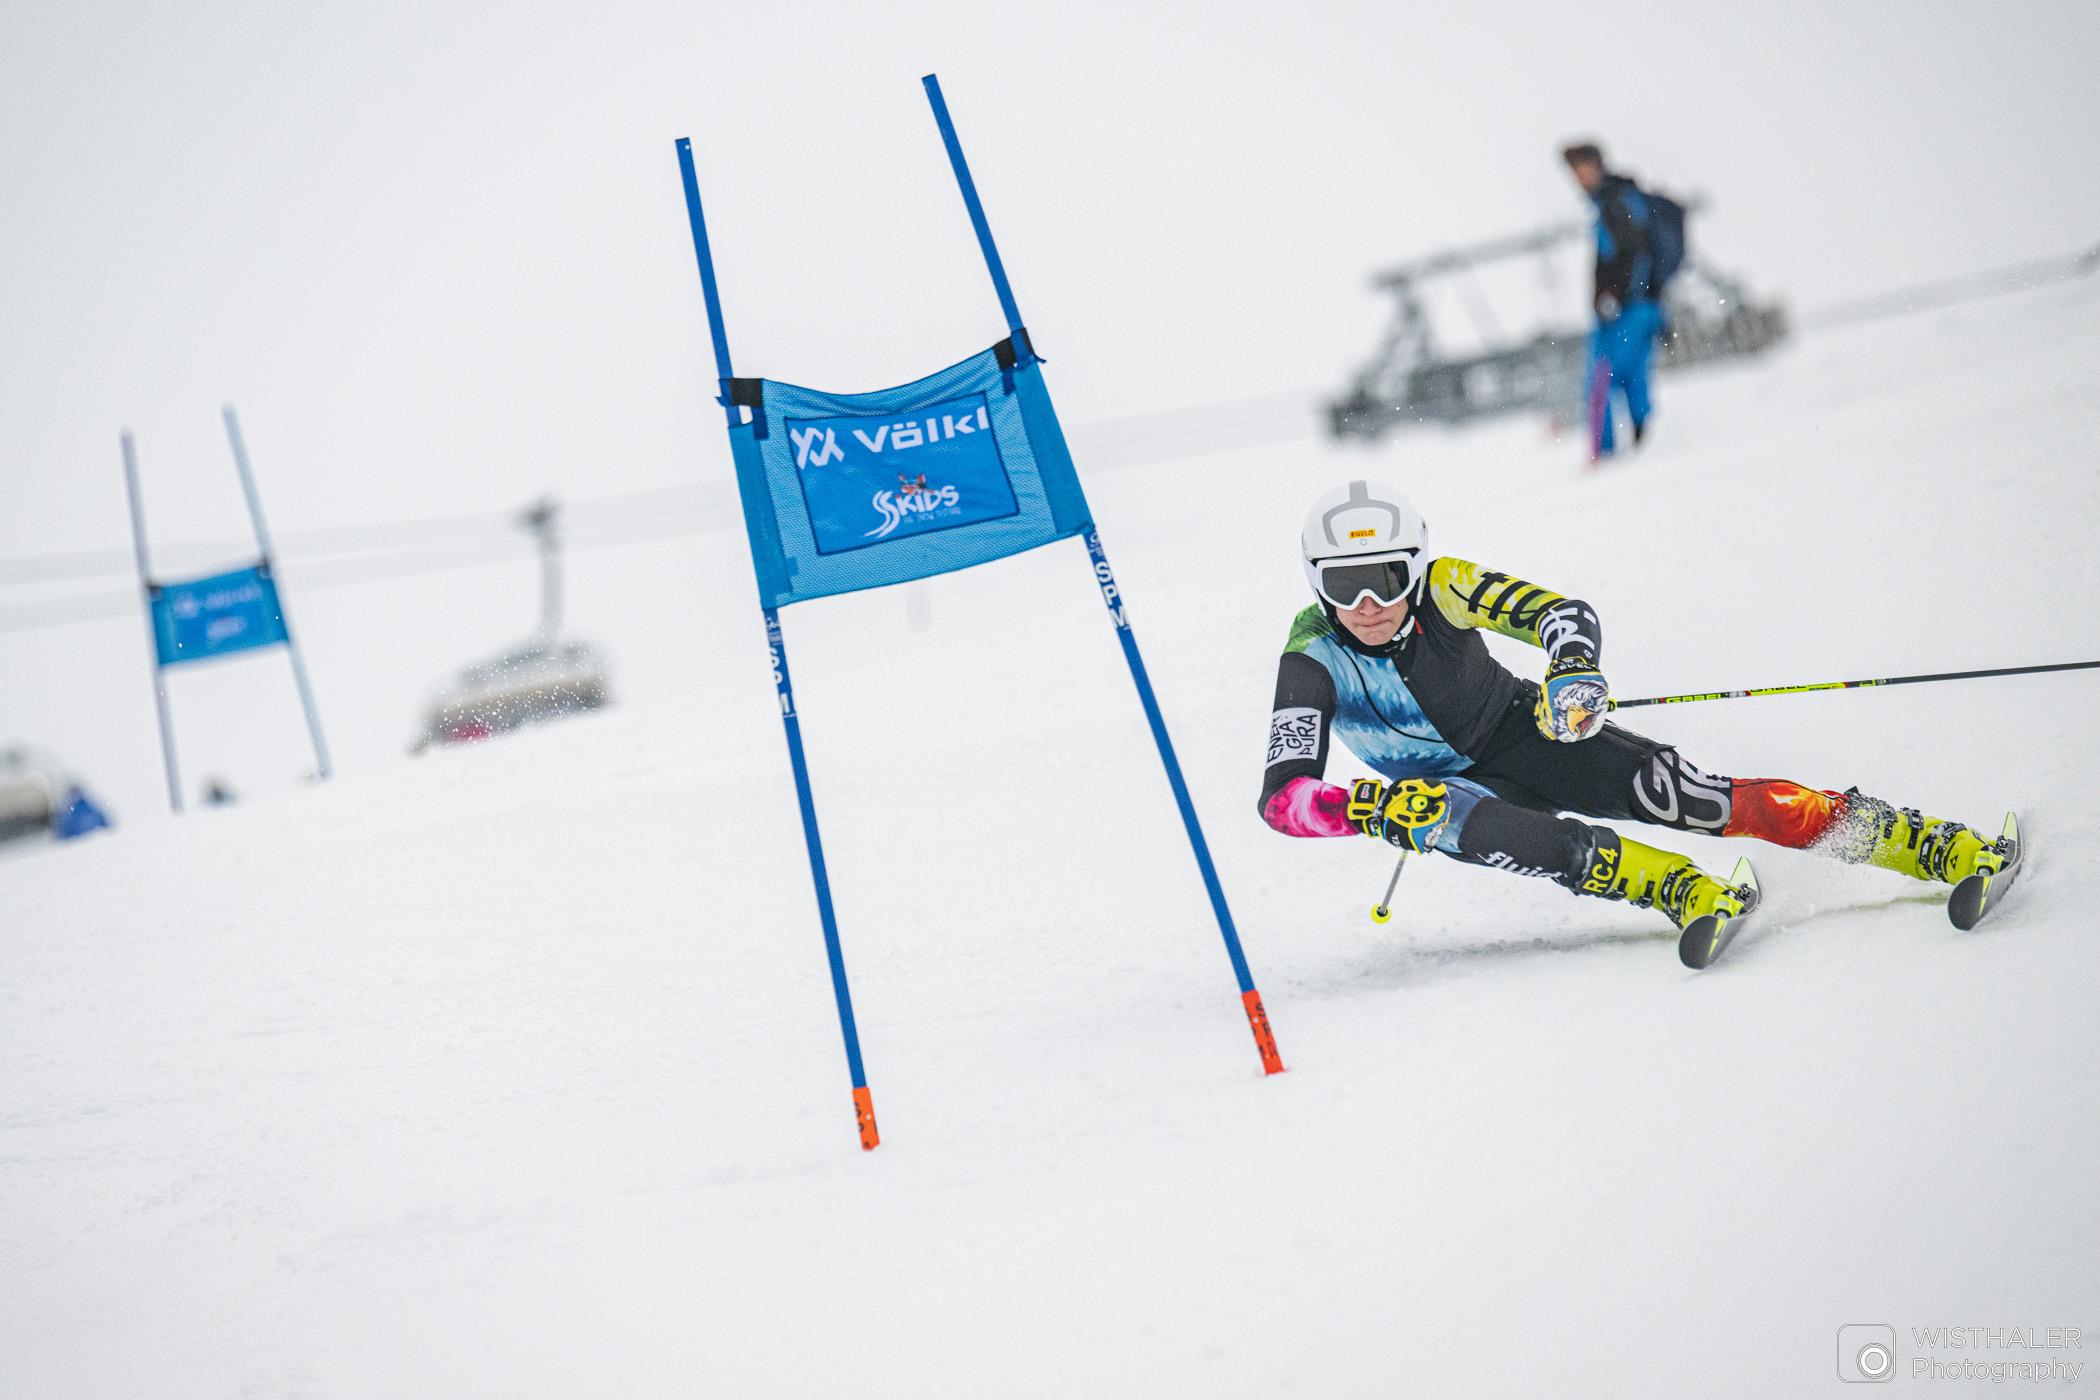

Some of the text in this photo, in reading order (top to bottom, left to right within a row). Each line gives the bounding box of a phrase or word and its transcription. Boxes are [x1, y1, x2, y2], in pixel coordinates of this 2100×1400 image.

[852, 405, 990, 453] Völkl
[1665, 693, 1722, 704] GABEL
[1279, 720, 1303, 749] GIA
[1296, 714, 1318, 756] PURA
[1583, 847, 1618, 893] RC4
